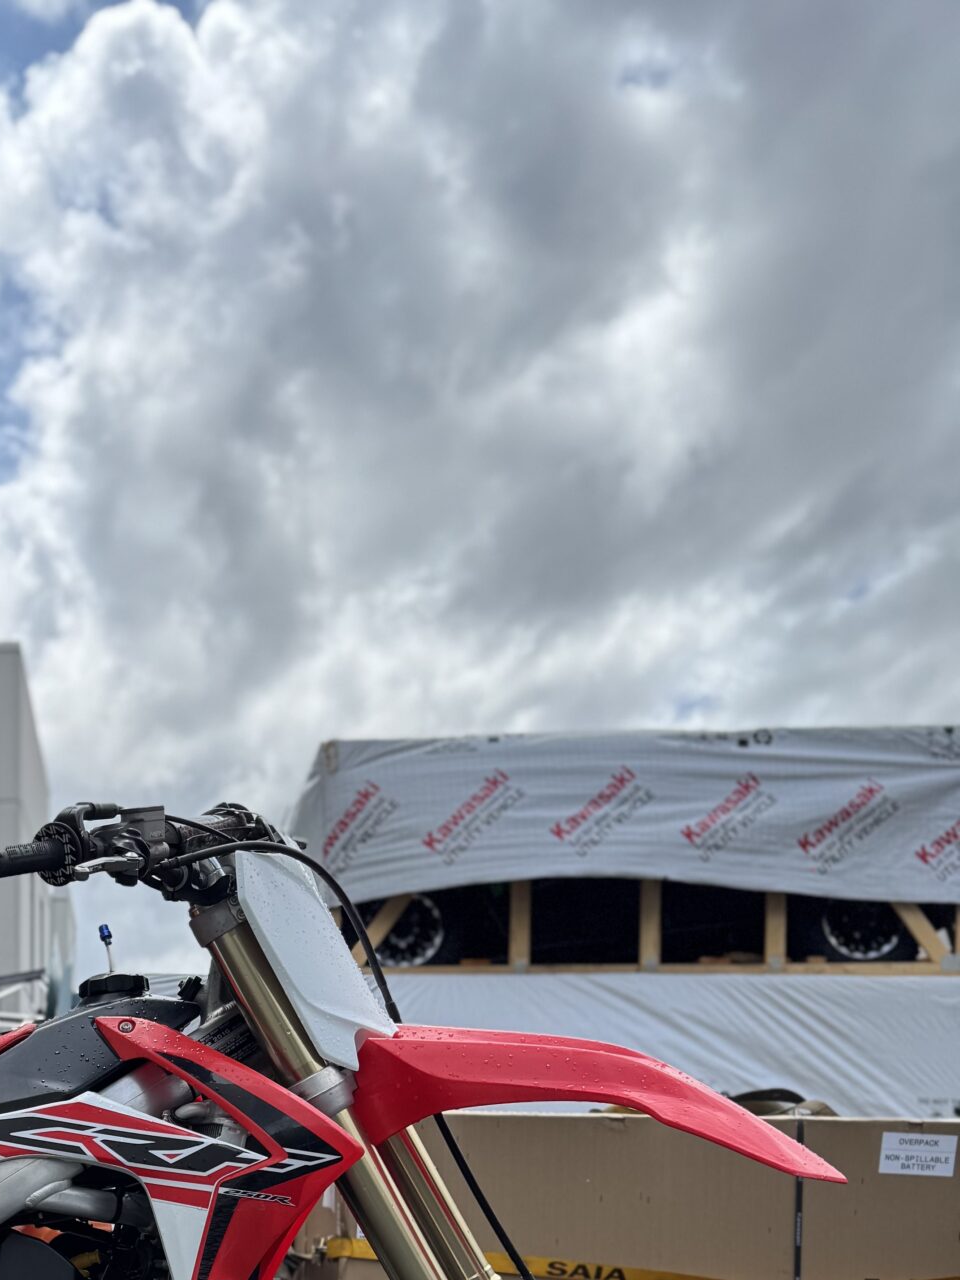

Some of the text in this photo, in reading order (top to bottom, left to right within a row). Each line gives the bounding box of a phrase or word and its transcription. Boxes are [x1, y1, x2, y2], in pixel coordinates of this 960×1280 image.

[322, 780, 381, 858] wasaki
[422, 768, 510, 852] Kawasaki
[549, 765, 637, 842] Kawasaki
[680, 772, 761, 844] Kawasaki
[796, 776, 885, 854] Kawasaki
[885, 1153, 950, 1165] NON-SPILLABLE
[898, 1138, 940, 1147] OVERPACK
[900, 1162, 936, 1171] BATTERY
[223, 1189, 296, 1207] 250R
